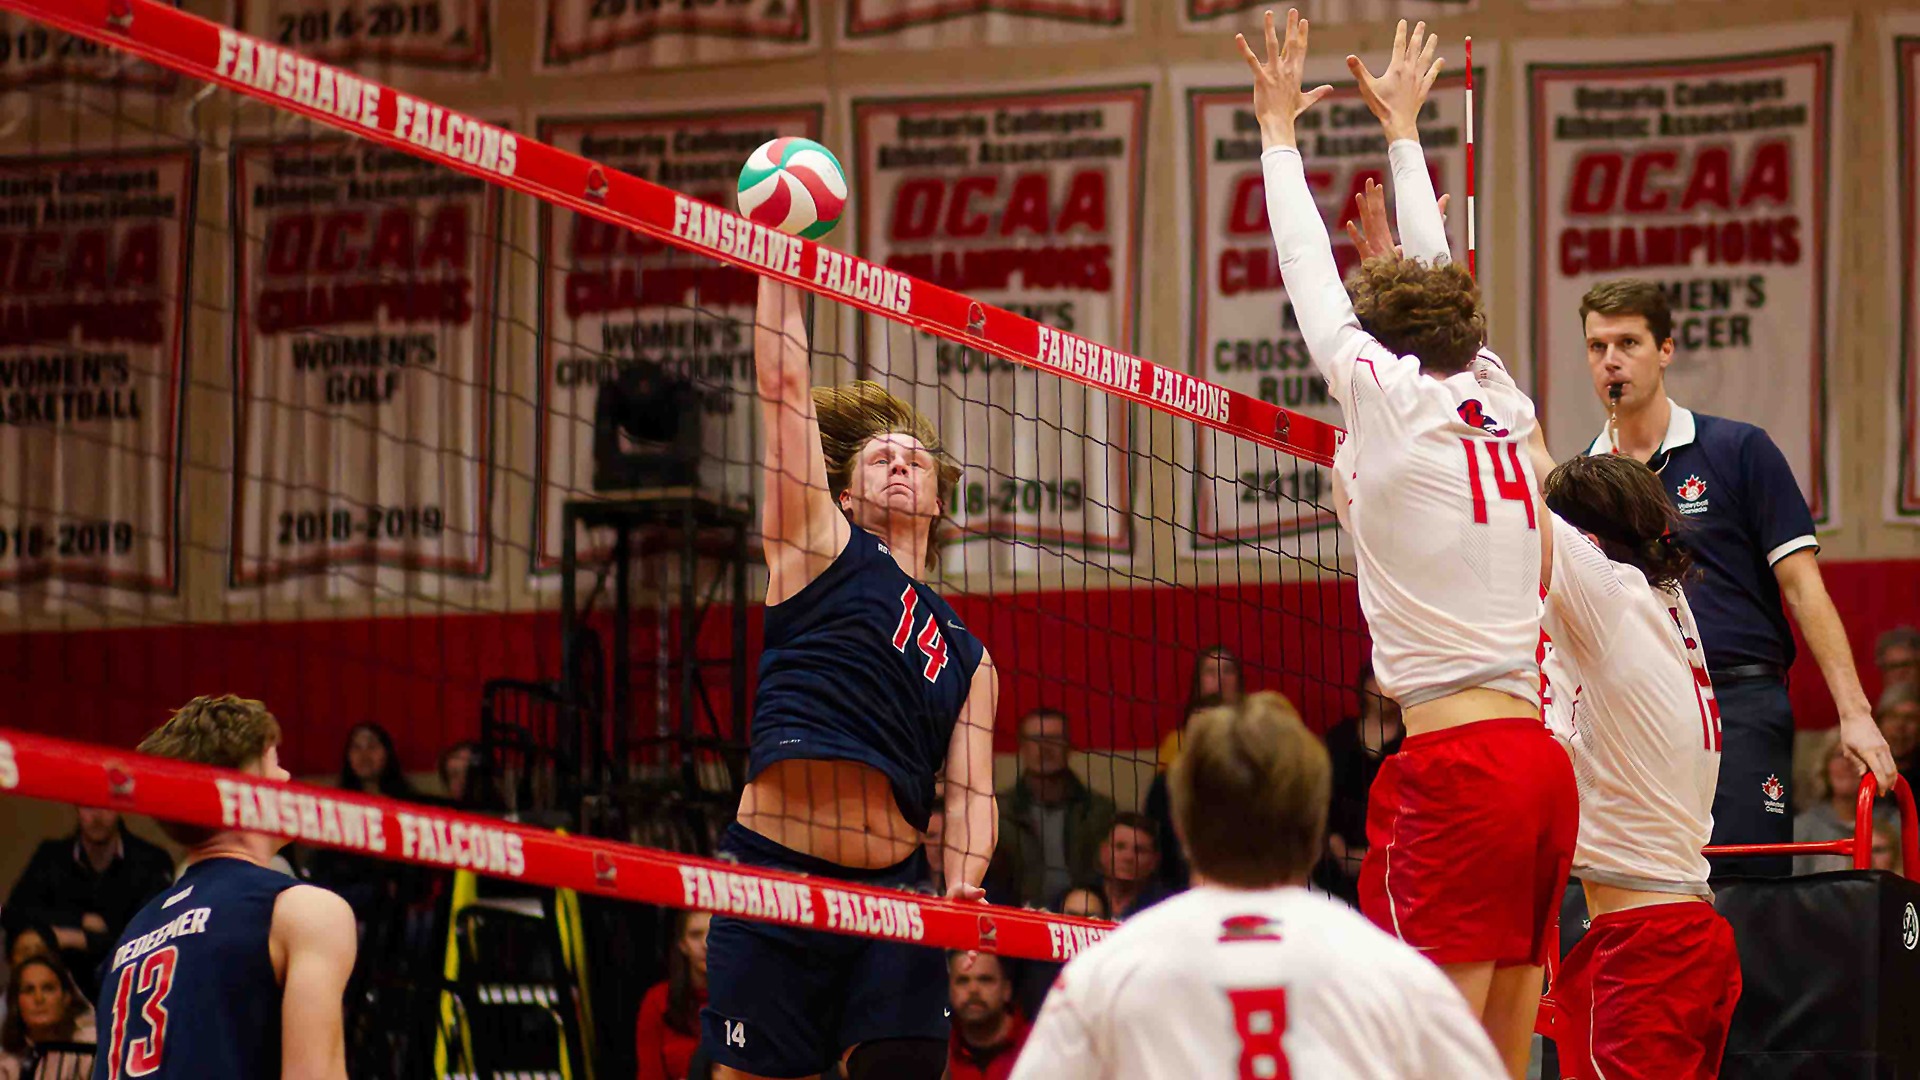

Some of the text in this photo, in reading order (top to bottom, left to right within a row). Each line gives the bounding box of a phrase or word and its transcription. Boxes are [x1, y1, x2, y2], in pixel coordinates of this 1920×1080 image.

[217, 27, 517, 177] FANSHAWE FALCONS
[892, 169, 1106, 241] OCAA
[1568, 140, 1789, 215] OCAA
[0, 225, 158, 292] CAA
[267, 205, 467, 276] OCAA
[673, 194, 804, 279] FANSHAWE
[813, 246, 912, 316] FALCONS
[1559, 216, 1800, 276] CHAMPIONS
[292, 336, 437, 369] WOMEN'S
[326, 371, 397, 404] GOLF
[1036, 324, 1230, 425] FANSHAWE FALCONS
[950, 477, 1082, 516] 18-2019
[1460, 437, 1536, 529] 14
[279, 504, 443, 545] 2018-2019
[892, 582, 950, 685] 14
[216, 778, 525, 877] FANSHAWE FALCONS
[680, 866, 925, 942] FANSHAWE FALCONS
[107, 944, 179, 1080] 13
[724, 1019, 747, 1048] 14
[1226, 986, 1293, 1080] 8
